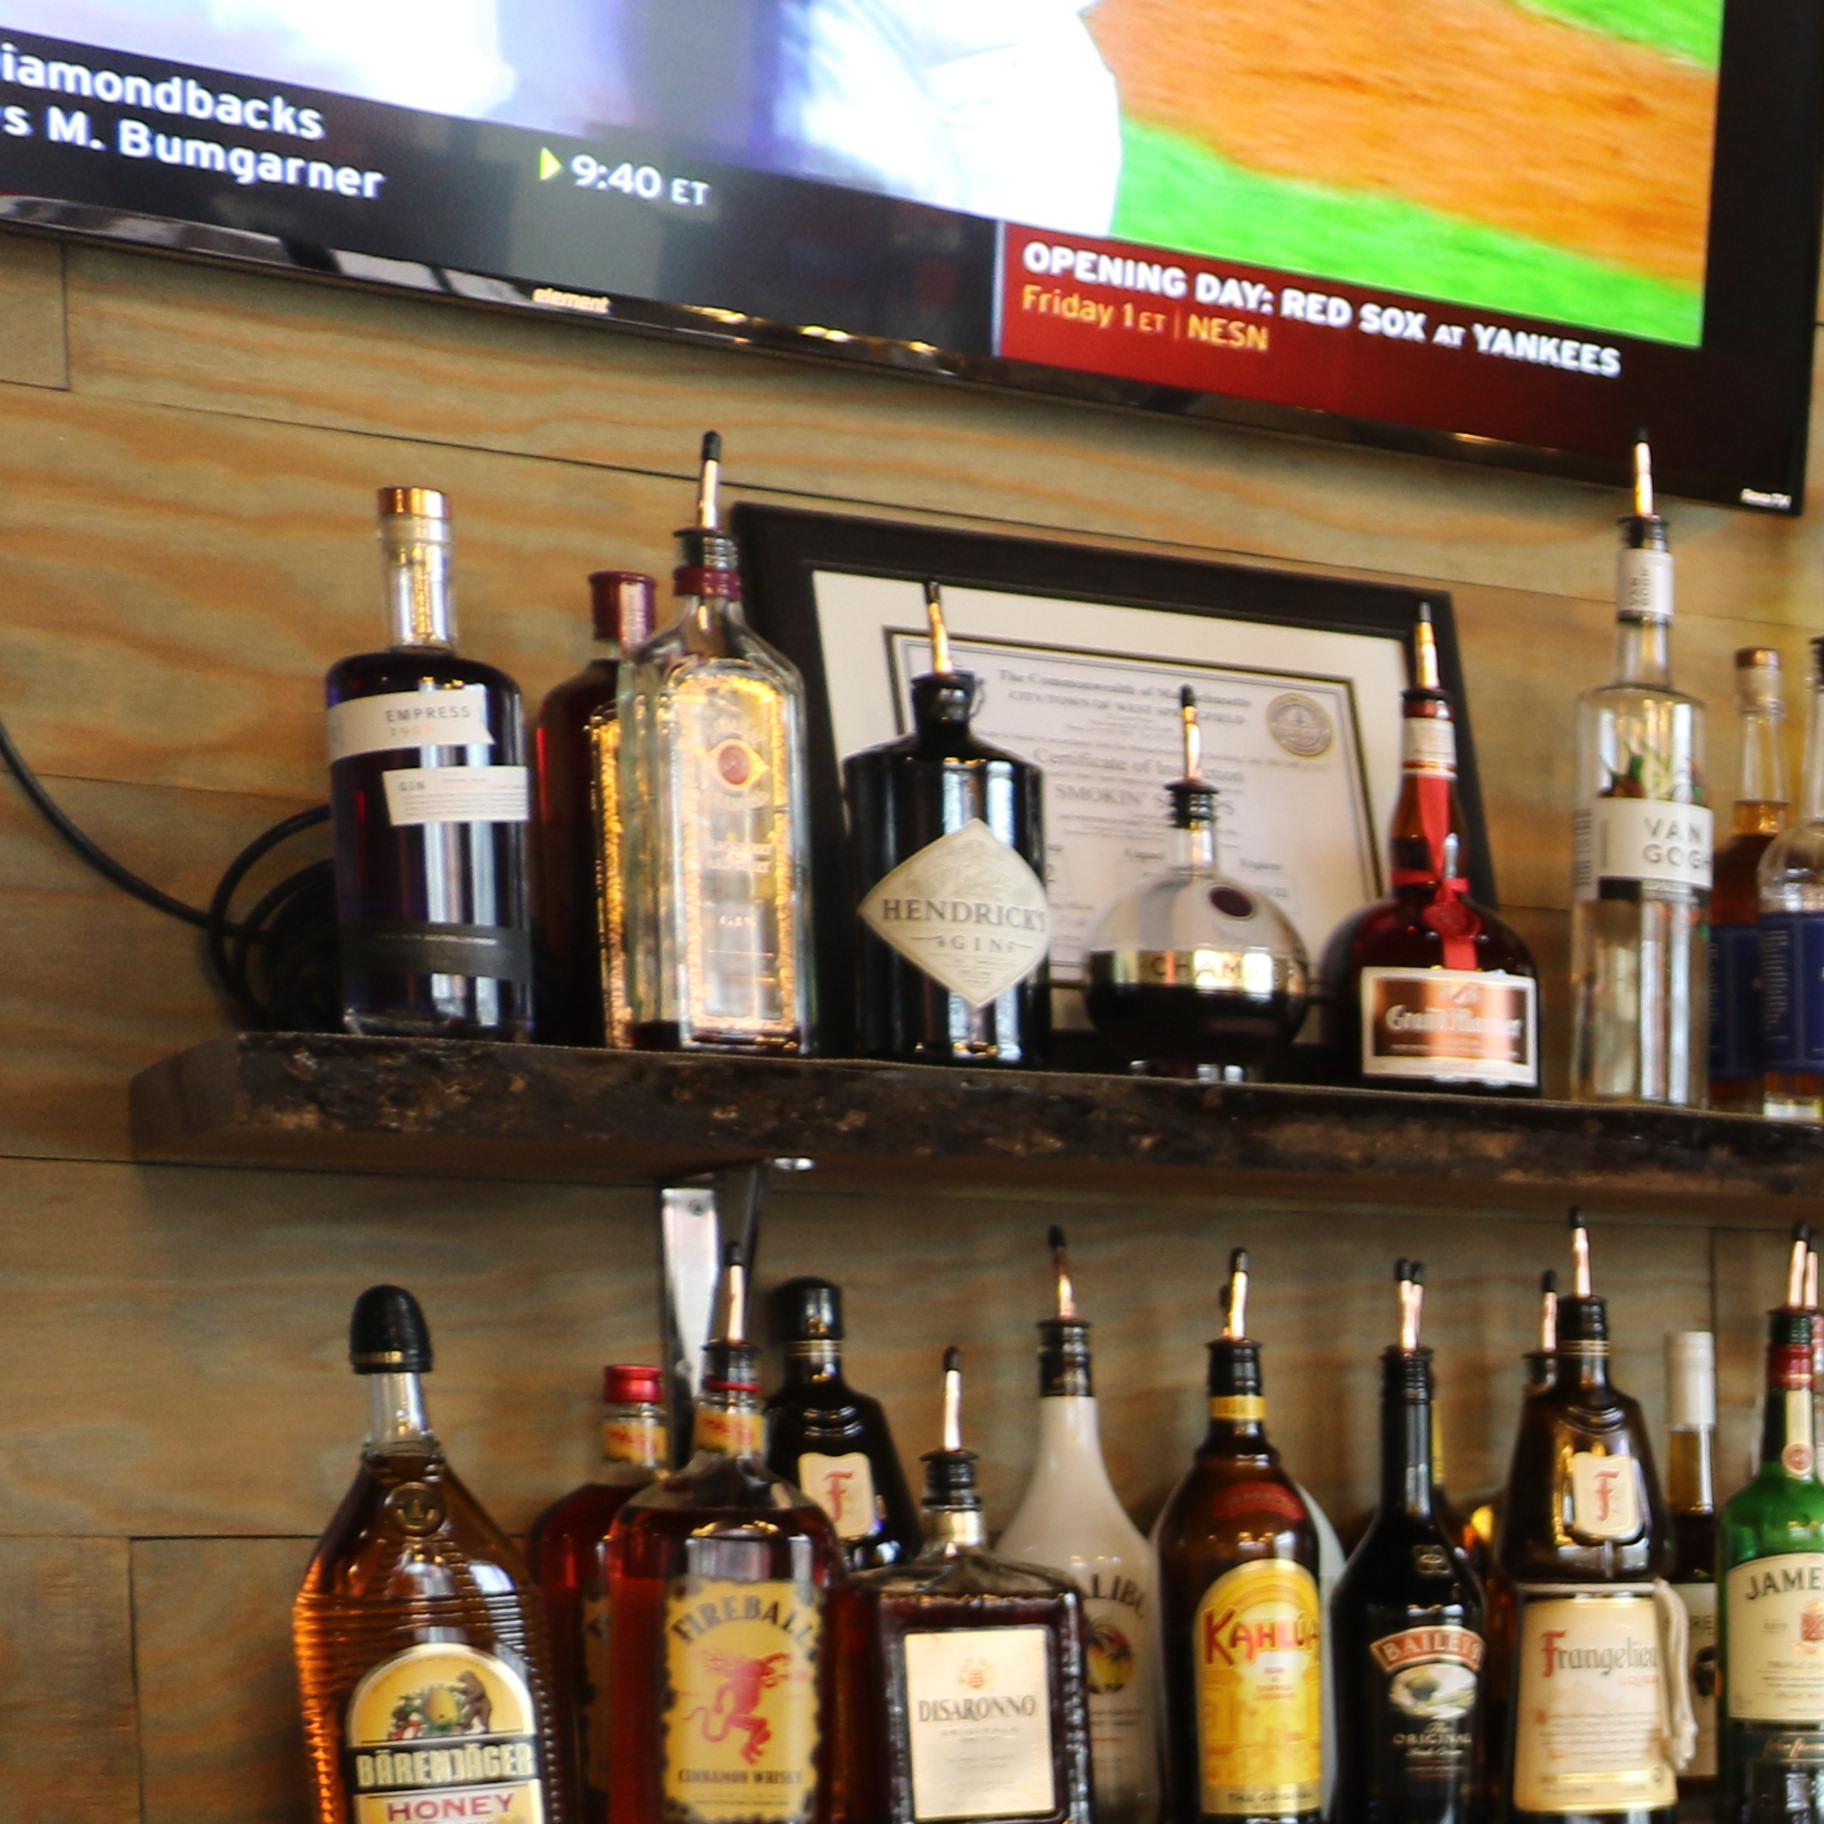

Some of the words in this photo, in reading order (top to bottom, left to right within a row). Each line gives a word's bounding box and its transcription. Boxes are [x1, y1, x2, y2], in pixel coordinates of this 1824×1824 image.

[47, 106, 107, 151] M.
[118, 118, 387, 198] Bumgarner
[570, 153, 663, 200] 9:40
[670, 178, 710, 208] ET
[532, 285, 610, 316] element
[1022, 240, 1188, 300] OPENING
[1195, 271, 1274, 316] DAY:
[1280, 285, 1352, 329] RED
[1358, 299, 1426, 343] SOX
[1433, 321, 1465, 349] AT
[1474, 323, 1621, 379] YANKEES
[1022, 282, 1115, 328] Friday
[1187, 313, 1269, 352] NESN
[385, 705, 471, 722] EMPRESS
[398, 780, 425, 791] GIN
[1644, 817, 1701, 840] VAN
[671, 1592, 818, 1647] FIREBALL
[1382, 1629, 1482, 1668] BAILEYS
[918, 1693, 1037, 1723] DISARONNO
[1393, 1731, 1472, 1747] ORIGINAL
[387, 1792, 515, 1822] HONEY
